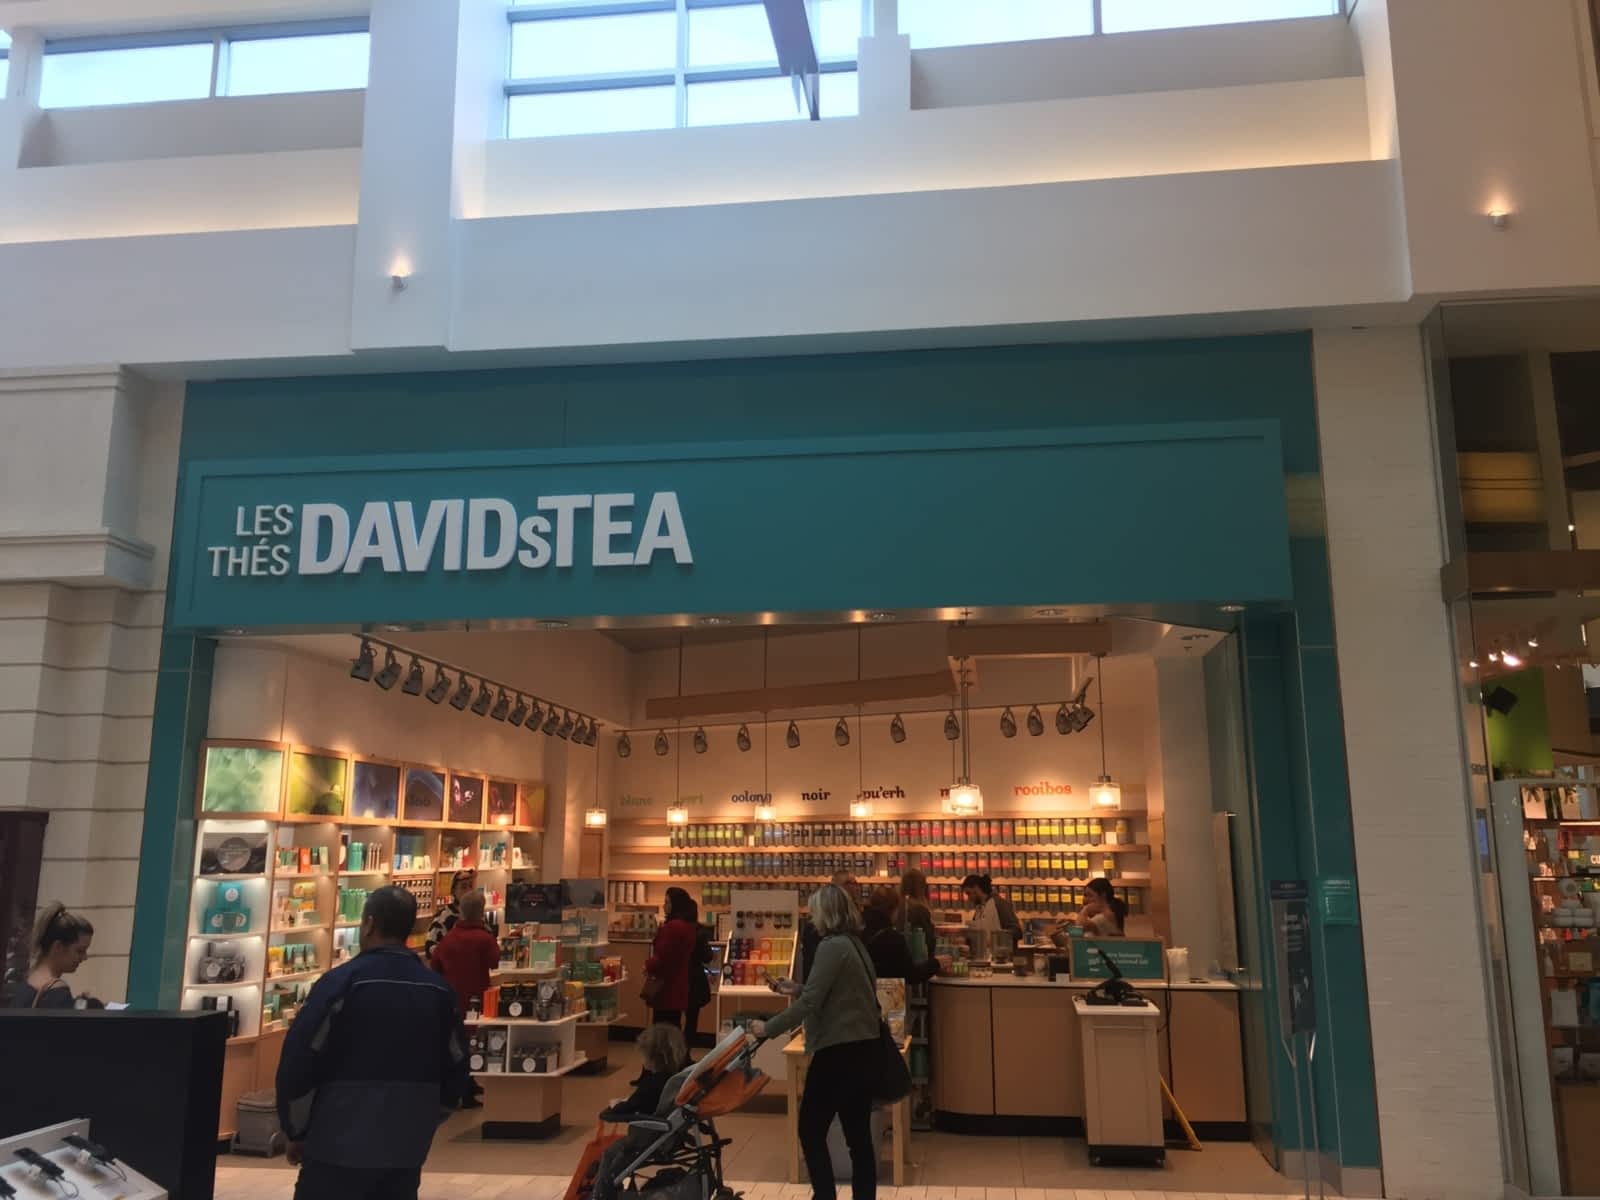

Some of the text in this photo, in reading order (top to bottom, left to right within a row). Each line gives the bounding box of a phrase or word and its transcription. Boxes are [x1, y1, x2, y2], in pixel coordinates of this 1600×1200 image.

[236, 504, 294, 536] LES
[298, 491, 693, 576] DAVIDsTEA
[207, 538, 291, 577] THÉS
[801, 788, 831, 801] noir
[861, 786, 906, 801] pu'erh
[1013, 781, 1073, 796] rooibos
[731, 790, 773, 803] oolong
